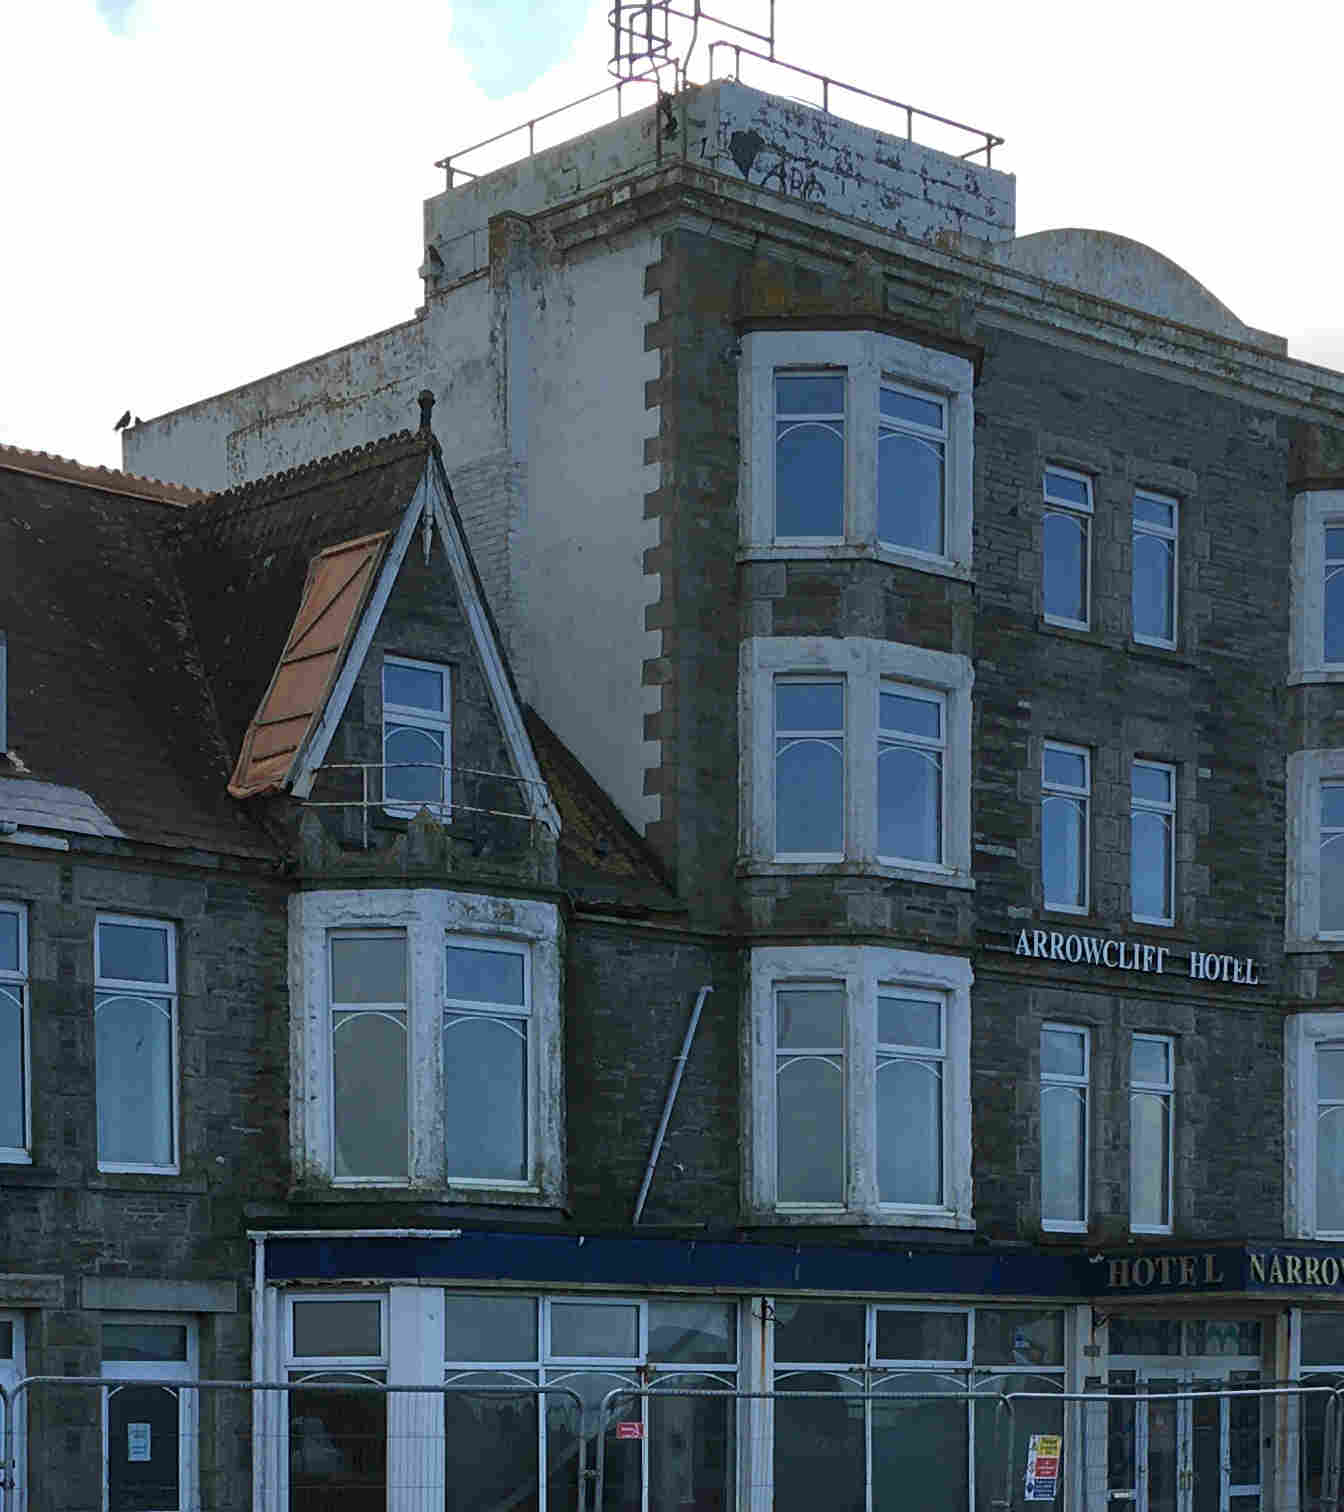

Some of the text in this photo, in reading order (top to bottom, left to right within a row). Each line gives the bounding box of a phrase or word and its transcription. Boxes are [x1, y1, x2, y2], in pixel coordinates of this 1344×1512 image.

[1015, 928, 1259, 985] ARROWCLIFF HOTEL
[1107, 1254, 1224, 1287] HOTEL
